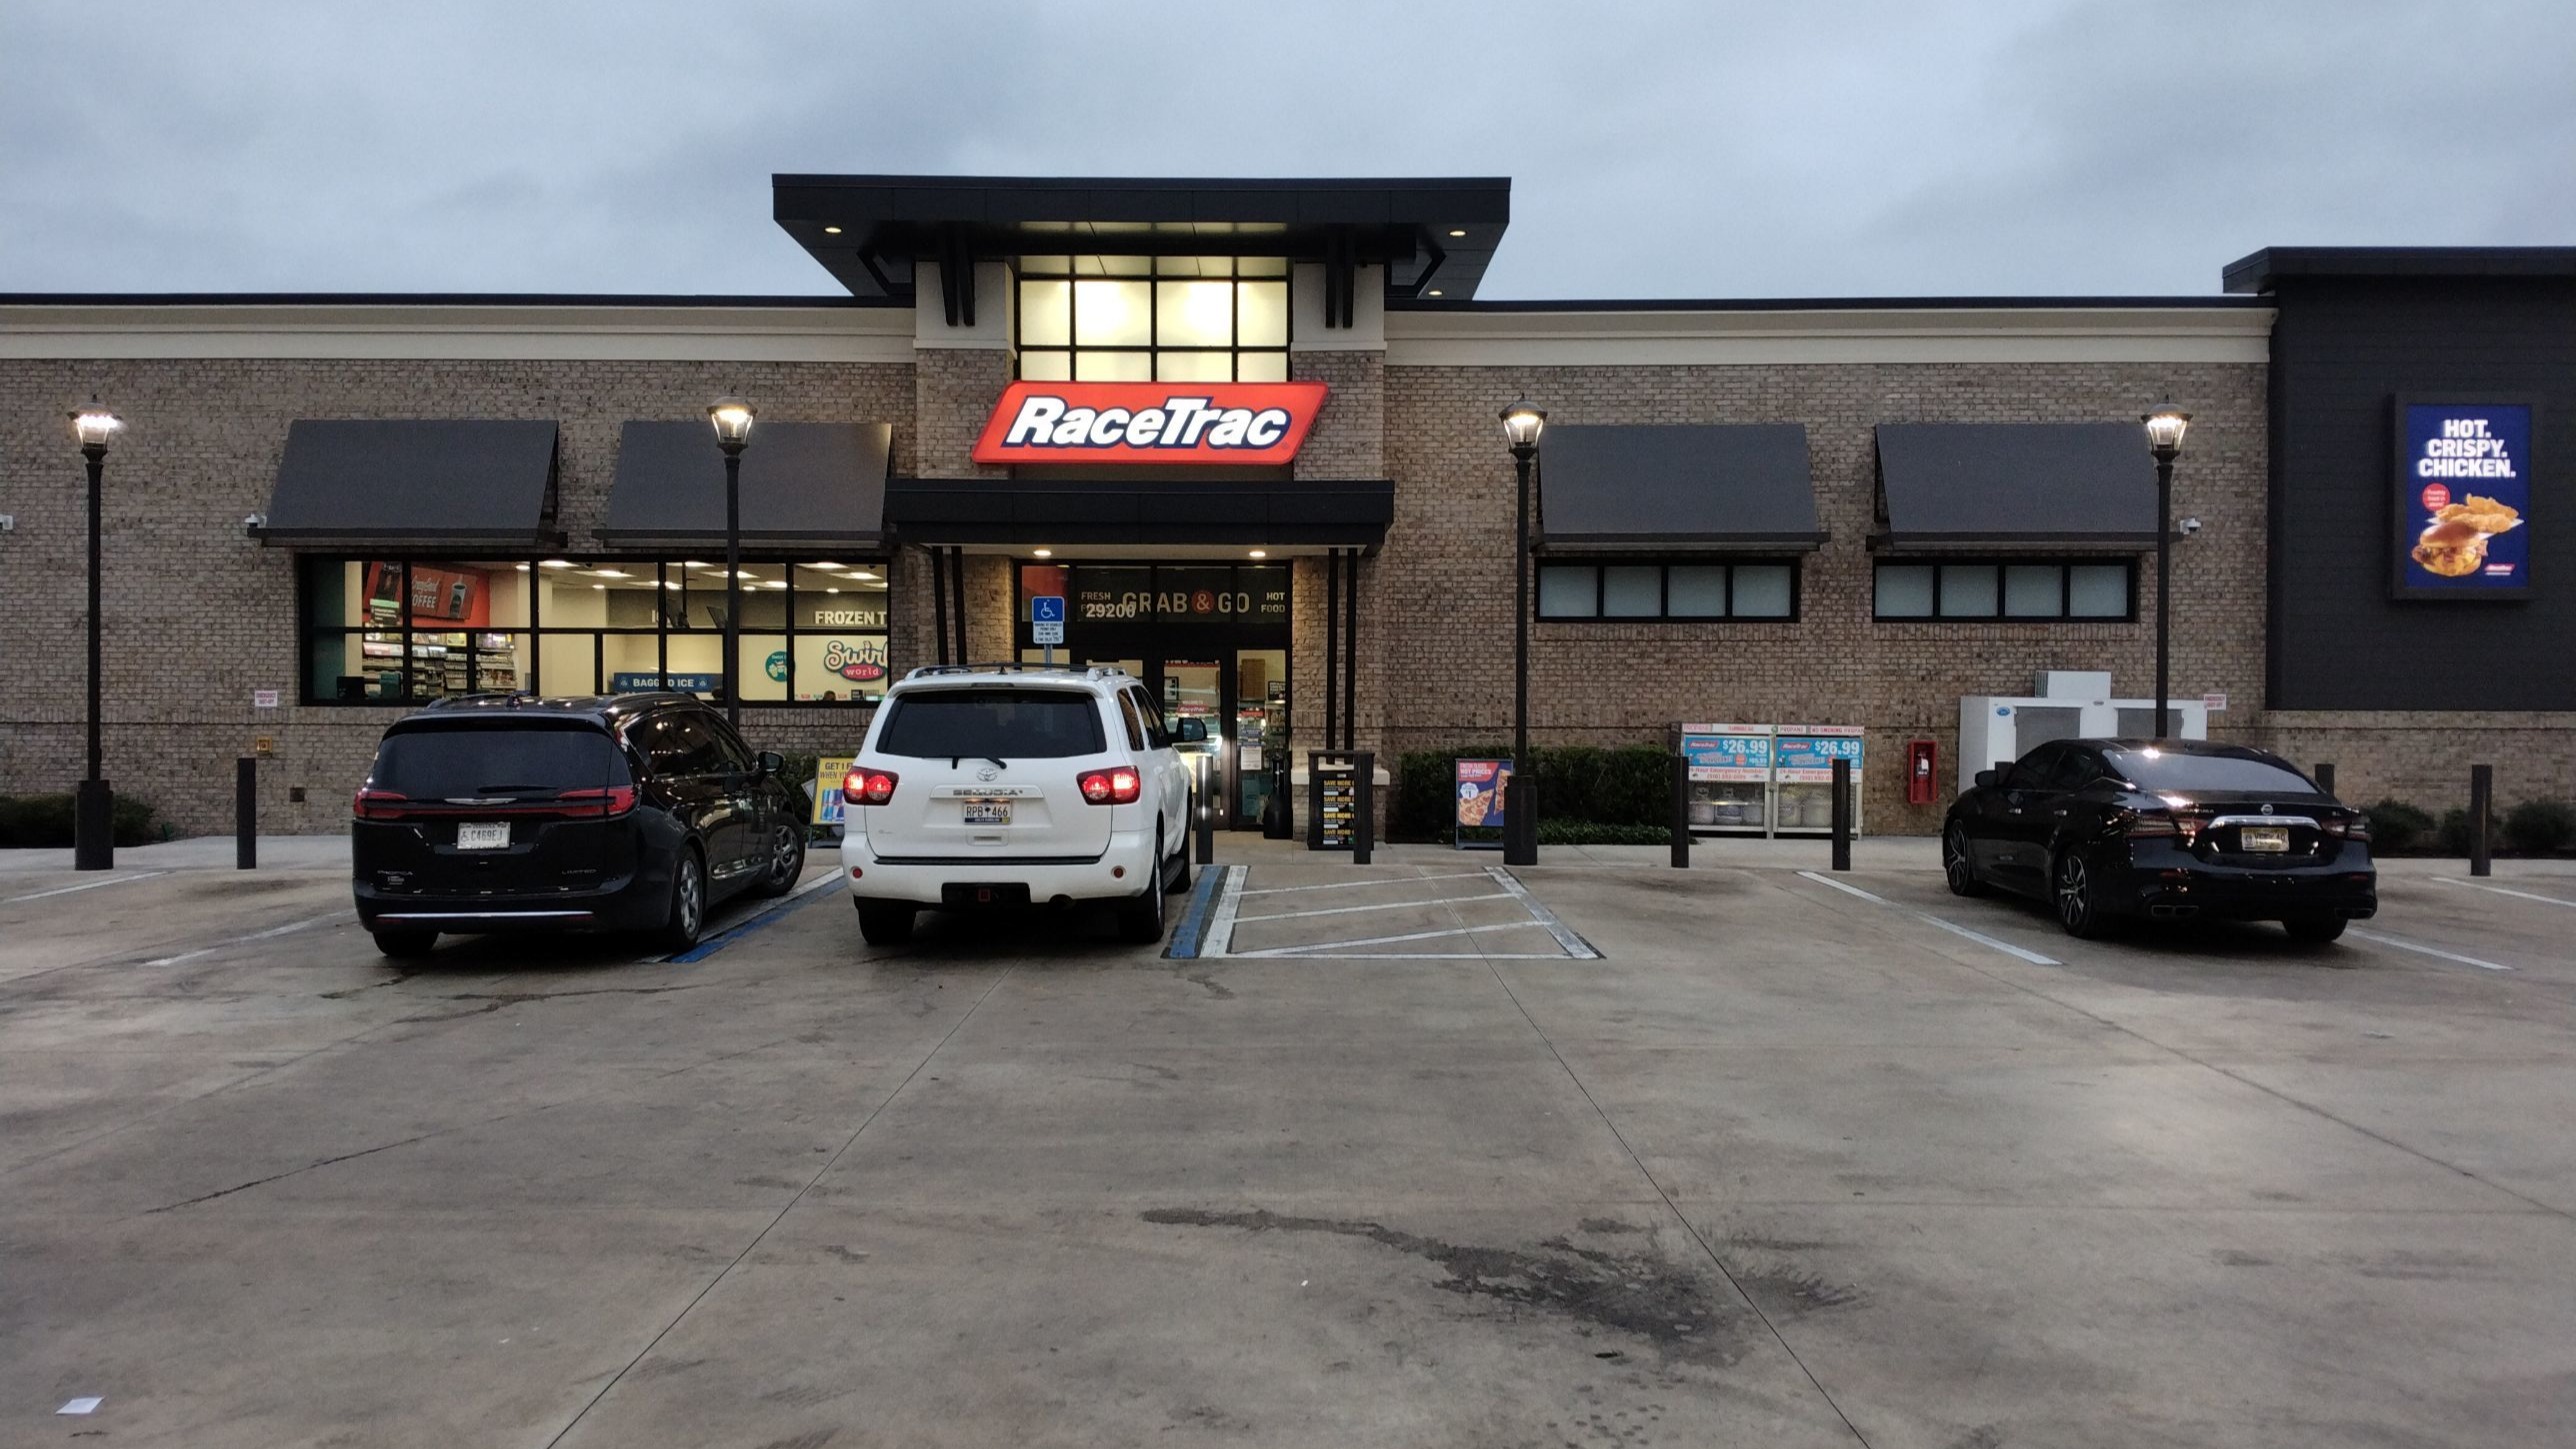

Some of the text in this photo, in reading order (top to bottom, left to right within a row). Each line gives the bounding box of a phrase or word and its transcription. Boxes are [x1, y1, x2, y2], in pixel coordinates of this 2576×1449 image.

[1003, 396, 1291, 449] RaceTrac
[2443, 419, 2492, 438] HOT.
[2426, 438, 2508, 458] CRISPY.
[2417, 458, 2517, 478] CHICKEN.
[411, 594, 437, 609] OFFEE
[1081, 591, 1111, 601] FRESH
[1122, 591, 1188, 614] GRAB
[1197, 592, 1210, 611] &
[1217, 592, 1250, 613] GO
[1266, 591, 1285, 601] HOT
[1085, 602, 1136, 618] 29200
[1260, 603, 1286, 613] FOOD
[815, 610, 874, 625] FROZEN
[845, 667, 880, 676] world
[632, 678, 694, 688] BAGGD ICE
[1722, 740, 1768, 753] $26.99
[1815, 740, 1860, 755] $26.99
[825, 761, 840, 770] GET
[820, 771, 838, 779] WHEN
[966, 806, 1008, 817] RPB 466
